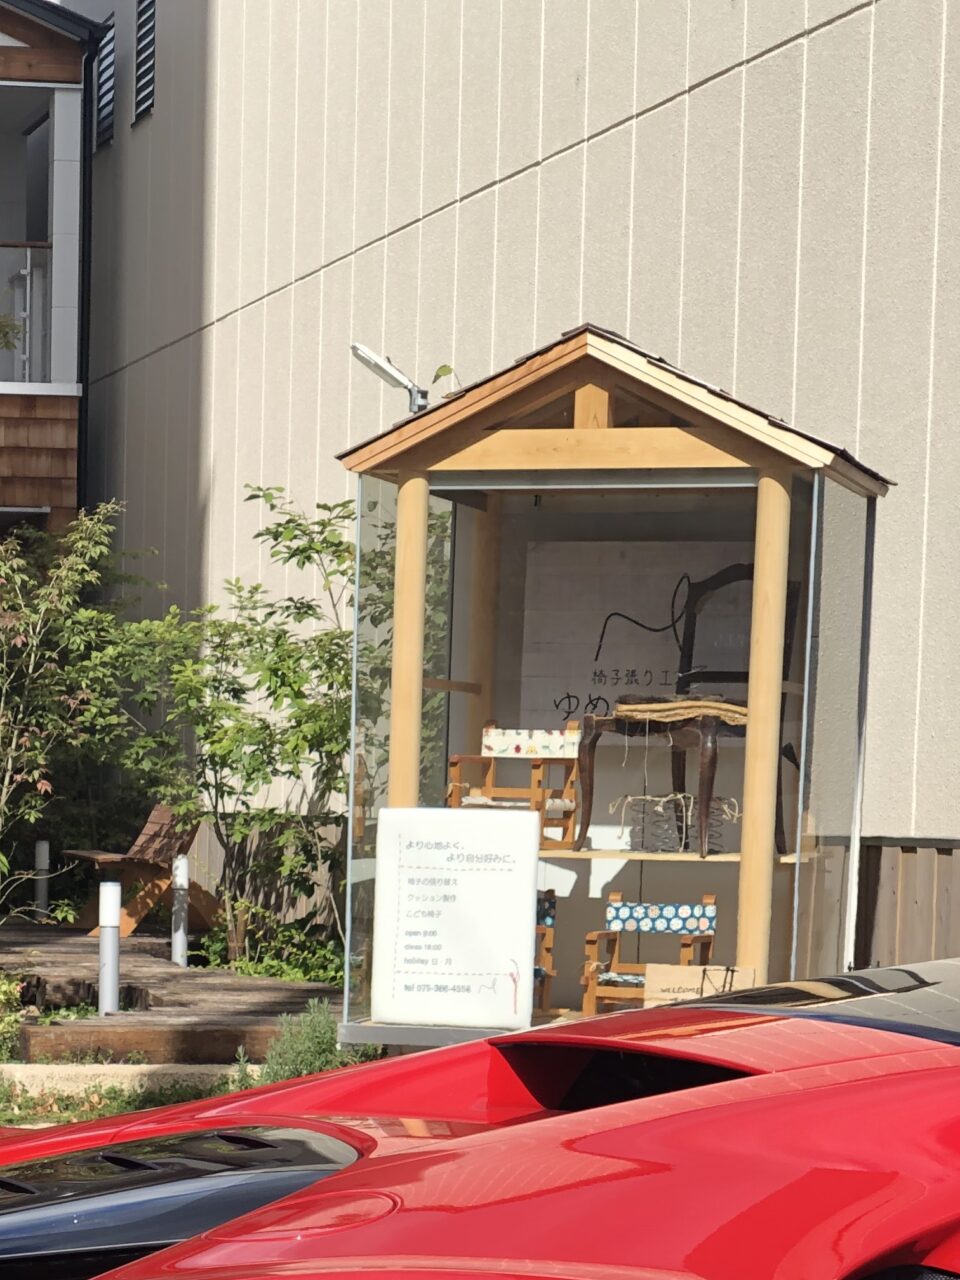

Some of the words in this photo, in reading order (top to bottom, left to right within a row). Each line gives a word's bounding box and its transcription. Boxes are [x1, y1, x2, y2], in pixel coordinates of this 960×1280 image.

[591, 668, 678, 686] 椅子張り工
